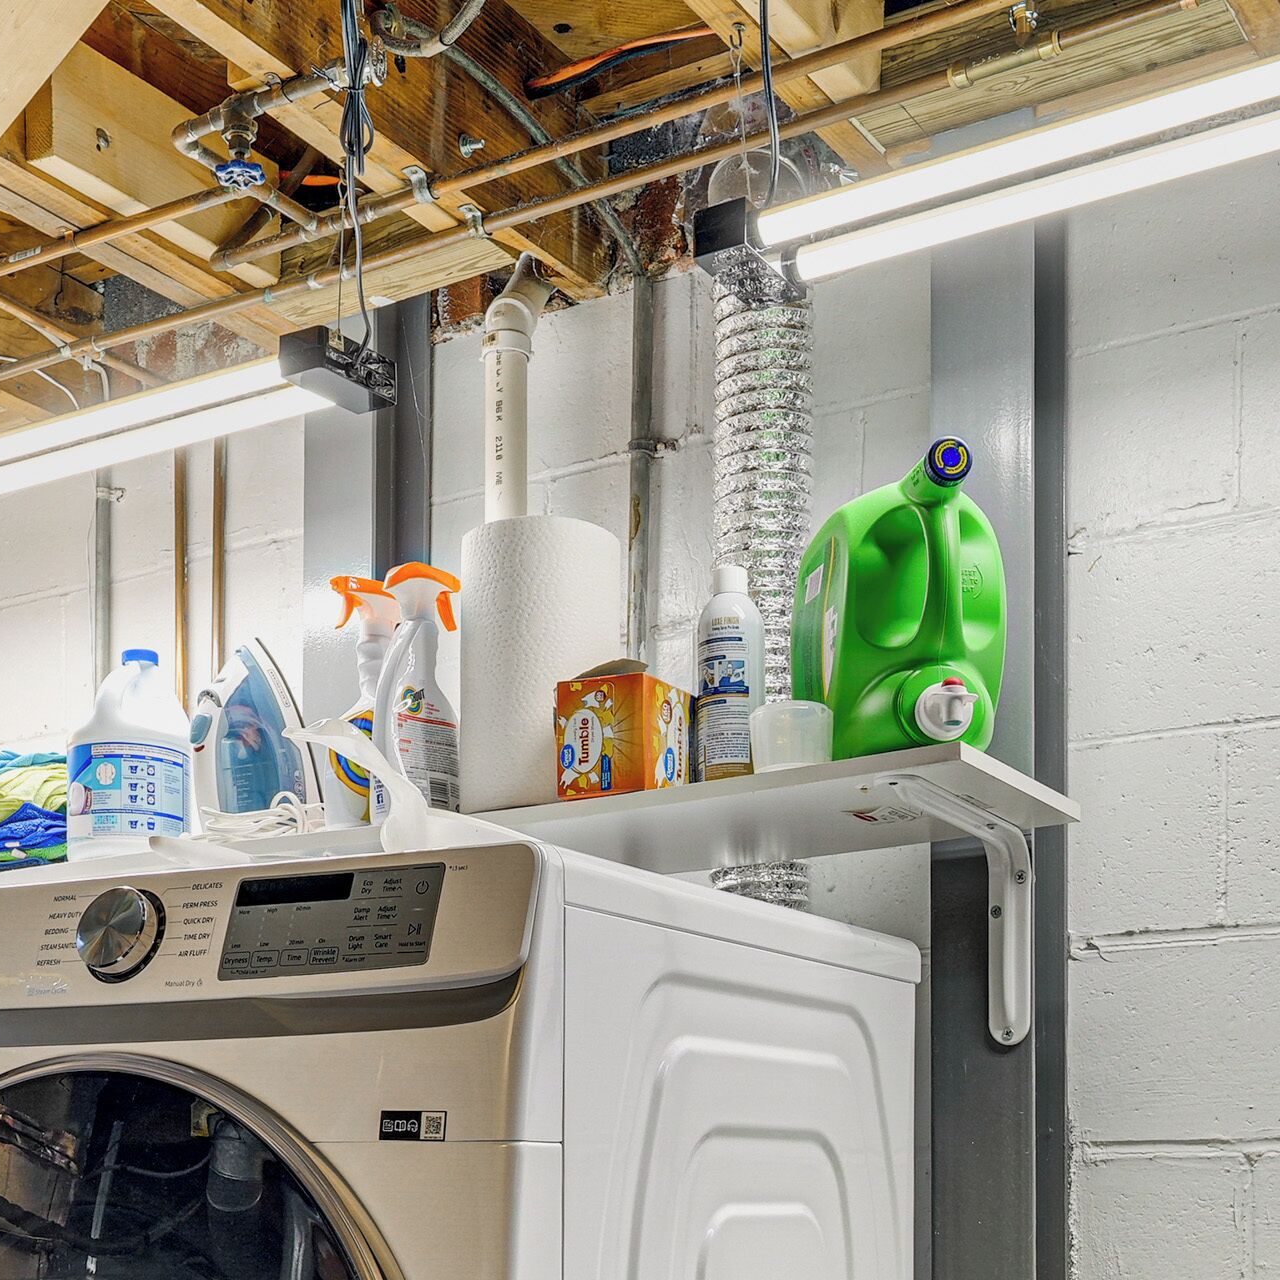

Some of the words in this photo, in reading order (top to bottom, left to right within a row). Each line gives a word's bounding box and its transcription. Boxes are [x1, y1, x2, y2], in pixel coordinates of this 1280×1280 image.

[579, 718, 589, 765] Tumble
[192, 882, 223, 890] DELICATES
[53, 894, 77, 902] NORMAL
[182, 901, 199, 909] PERM
[200, 900, 218, 908] PRESS
[354, 906, 370, 915] Damp
[377, 905, 397, 913] Adjust
[49, 912, 67, 920] HEAVY
[202, 916, 214, 924] DRY
[348, 941, 363, 950] Light
[313, 948, 335, 956] Wrinkle
[224, 956, 248, 966] Dryness
